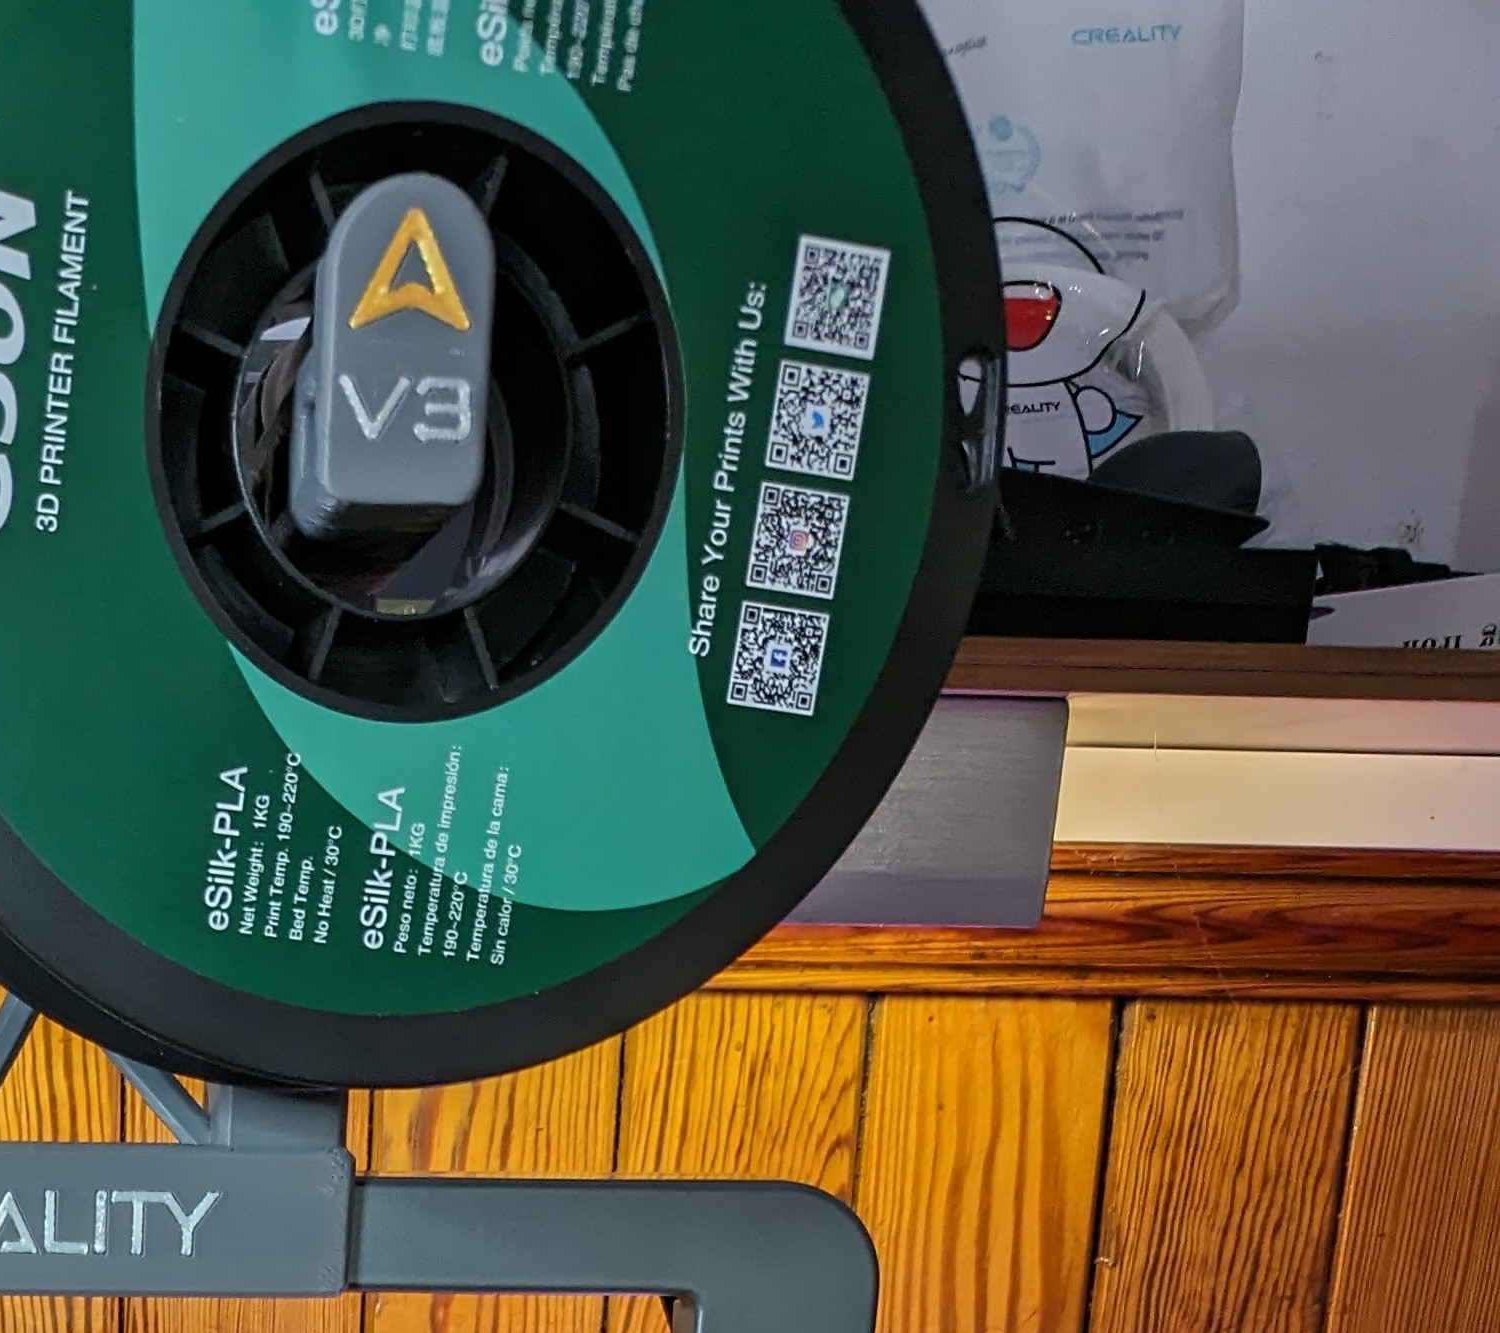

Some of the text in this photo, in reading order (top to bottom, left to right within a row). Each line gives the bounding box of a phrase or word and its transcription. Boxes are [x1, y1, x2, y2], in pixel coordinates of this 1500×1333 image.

[1071, 24, 1182, 45] CREALITY
[36, 189, 91, 534] 3D PRINTER FILAMENT
[339, 375, 472, 442] V3
[1004, 401, 1060, 414] EALITY
[690, 281, 767, 656] Share Your Prints With Us:
[205, 766, 248, 931] eSilk-PLA
[238, 795, 270, 935] Net Weight: 1KG
[270, 848, 290, 899] Temp.
[360, 787, 406, 949] eSilk-PLA
[466, 861, 495, 962] Temperatura
[491, 766, 509, 818] cama:
[264, 905, 281, 938] Print
[288, 856, 314, 941] Bed Temp.
[319, 878, 335, 917] Heat
[394, 822, 426, 954] Peso neto: 1KG
[417, 855, 445, 956] Temperatura
[495, 897, 514, 937] calor
[313, 921, 329, 944] No
[490, 940, 506, 966] Sin
